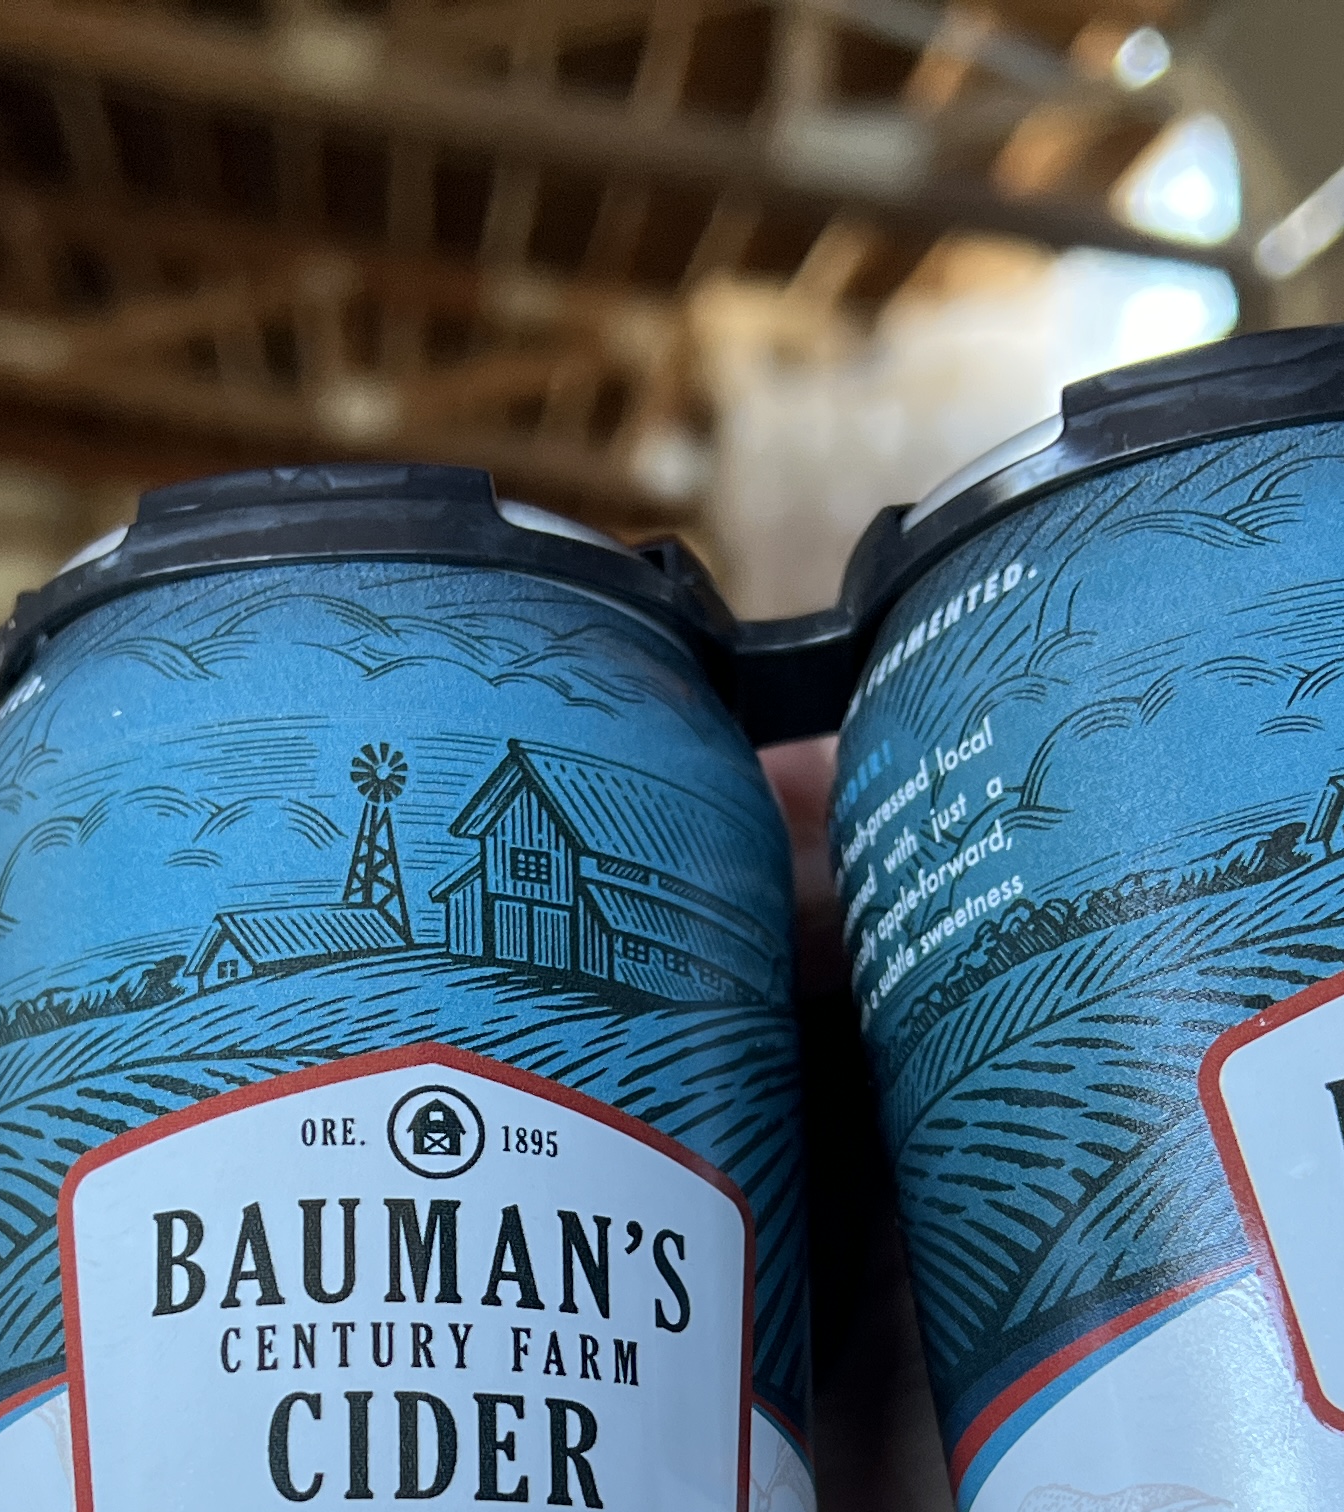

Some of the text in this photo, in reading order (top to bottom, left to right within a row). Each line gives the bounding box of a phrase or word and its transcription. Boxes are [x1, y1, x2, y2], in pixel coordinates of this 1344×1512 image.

[865, 563, 1039, 697] FERMENTED.
[935, 714, 994, 777] local
[877, 818, 1013, 942] apple-forward,
[882, 775, 1004, 875] with just a
[878, 943, 916, 998] subtle
[919, 873, 1025, 955] sweetness
[301, 1117, 559, 1158] ORE. 1895
[151, 1196, 692, 1334] BAUMAN'S
[220, 1321, 640, 1387] CENTURY FARM
[266, 1389, 605, 1511] CIDER
